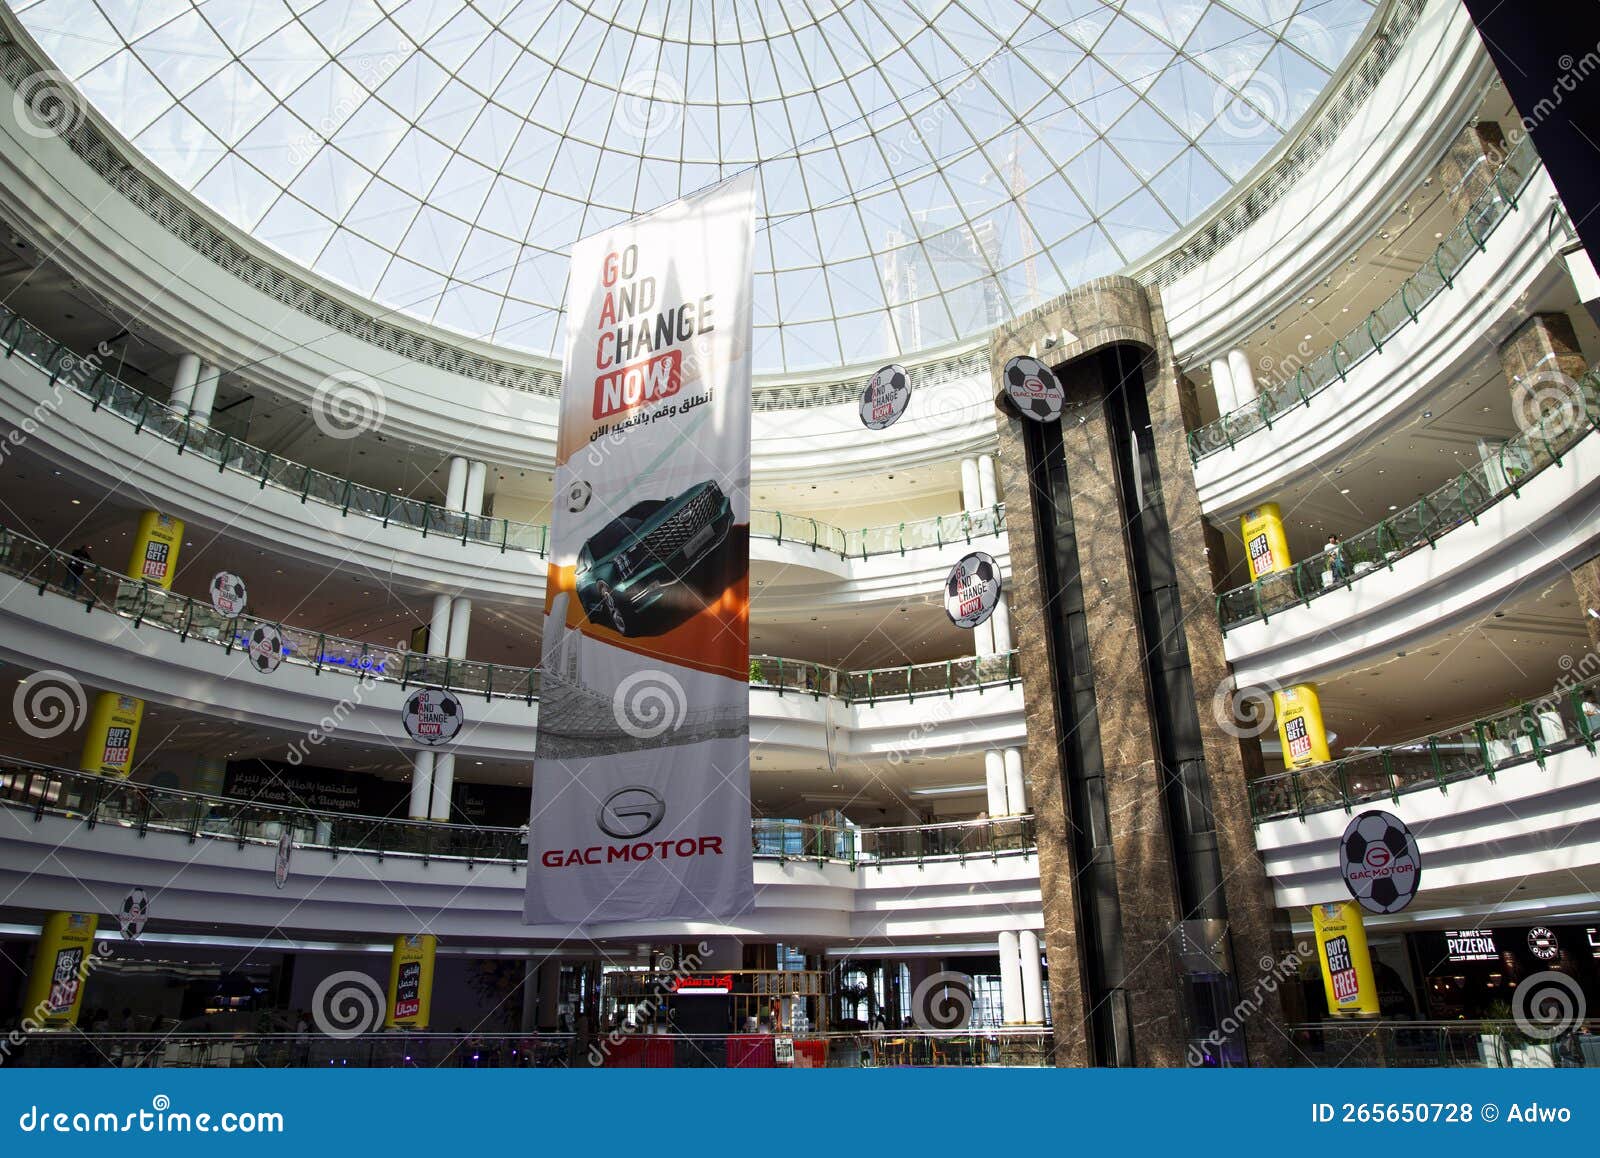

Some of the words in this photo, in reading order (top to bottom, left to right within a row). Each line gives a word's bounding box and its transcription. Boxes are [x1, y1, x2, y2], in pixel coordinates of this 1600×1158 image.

[602, 244, 638, 288] GO
[598, 276, 656, 330] AND
[596, 293, 715, 370] CHANGE
[601, 356, 674, 414] NOW
[652, 404, 677, 423] وقم
[149, 541, 163, 553] BUY
[162, 544, 168, 554] 2
[1250, 536, 1261, 550] BUY
[147, 550, 161, 561] GET
[1252, 546, 1264, 559] GET
[144, 560, 166, 576] FREE
[1254, 552, 1272, 574] FREE
[956, 566, 966, 579] GO
[957, 575, 972, 591] AND
[959, 580, 988, 602] CHANGE
[961, 598, 980, 617] NOW
[419, 692, 430, 703] GO
[418, 703, 434, 713] AND
[418, 713, 448, 723] CHANGE
[1286, 719, 1299, 732] BUY
[1298, 717, 1304, 727] 2
[109, 728, 125, 738] BUY
[124, 729, 130, 738] 2
[420, 724, 438, 733] NOW
[1287, 728, 1301, 741] GET
[107, 736, 123, 747] GET
[1290, 735, 1311, 756] FREE
[103, 748, 130, 762] FREE
[542, 846, 602, 868] GAC
[607, 835, 723, 864] MOTOR
[1350, 870, 1372, 880] GAC
[1372, 863, 1414, 877] MOTOR
[1459, 930, 1480, 938] JAMIE'S
[1531, 928, 1552, 938] JAMIE
[1326, 940, 1341, 957] BUY
[1340, 938, 1347, 952] 2
[1447, 938, 1496, 954] PIZZERIA
[1532, 946, 1556, 958] OLIVER
[1329, 954, 1344, 972] GET
[1344, 955, 1350, 968] 1
[1333, 969, 1358, 999] FREE
